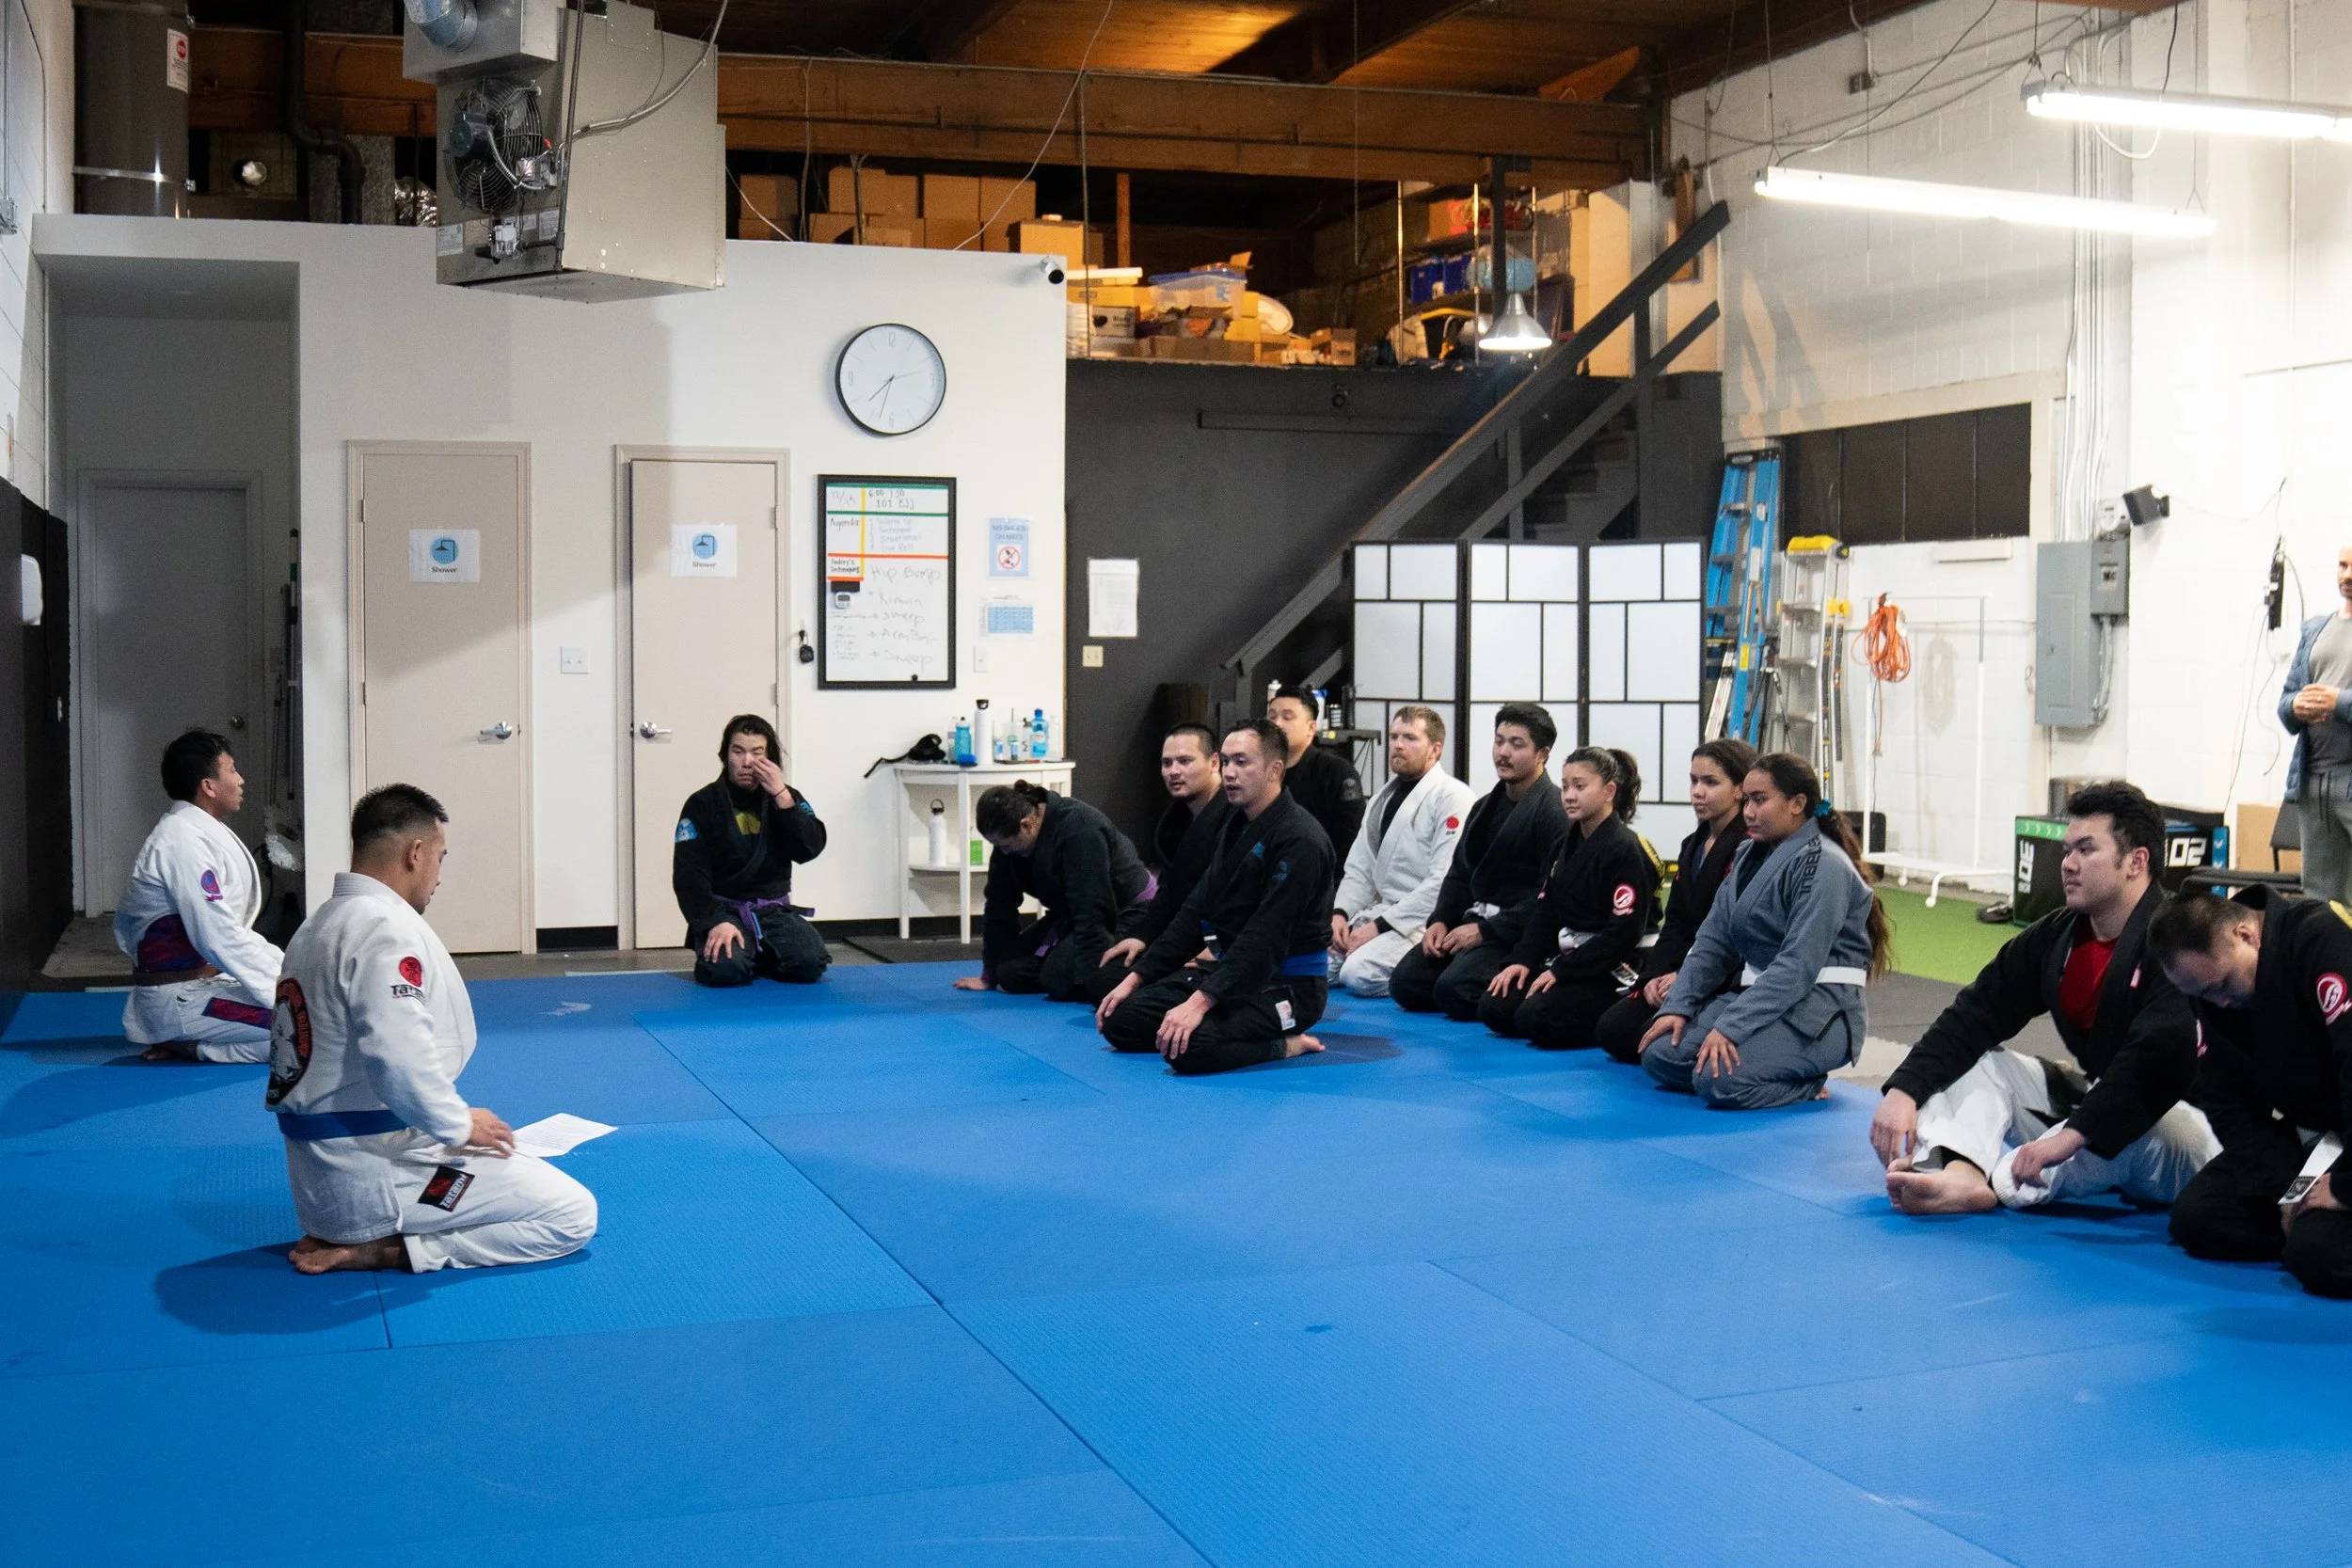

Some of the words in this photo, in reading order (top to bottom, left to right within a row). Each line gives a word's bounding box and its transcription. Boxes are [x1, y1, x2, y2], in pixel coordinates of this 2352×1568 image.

[888, 331, 897, 348] 12
[888, 412, 895, 428] 6
[830, 518, 860, 531] Agenda
[431, 565, 457, 574] Shower
